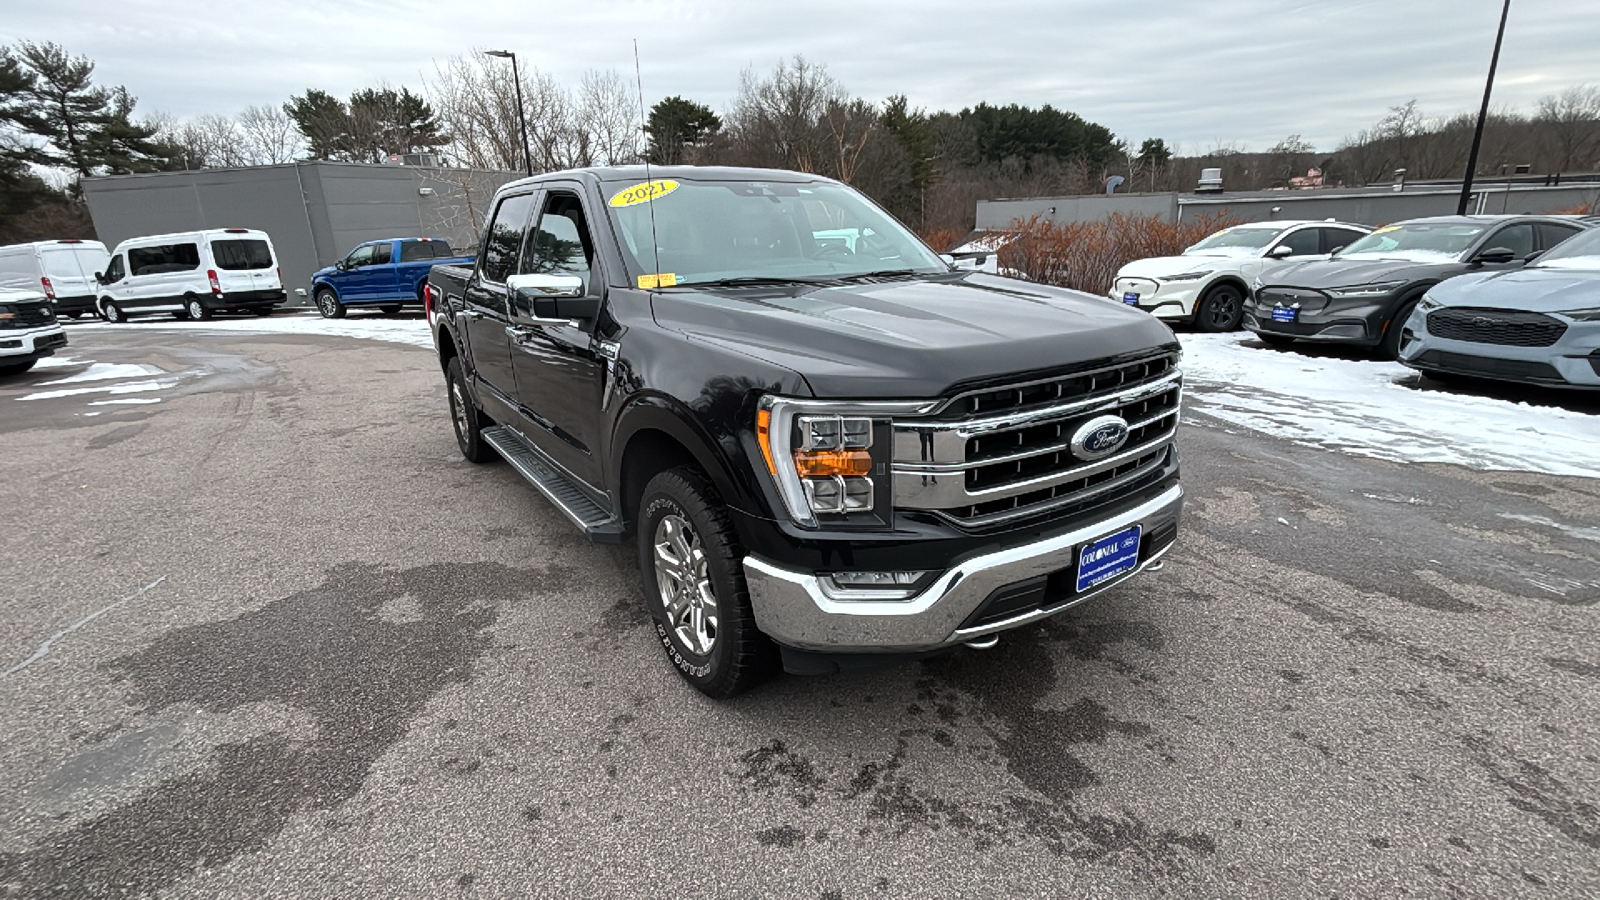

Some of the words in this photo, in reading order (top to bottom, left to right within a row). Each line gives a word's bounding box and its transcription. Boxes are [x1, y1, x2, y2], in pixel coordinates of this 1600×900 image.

[623, 182, 668, 204] 2021
[1093, 428, 1120, 449] Ford
[1081, 542, 1119, 567] COLONIAL
